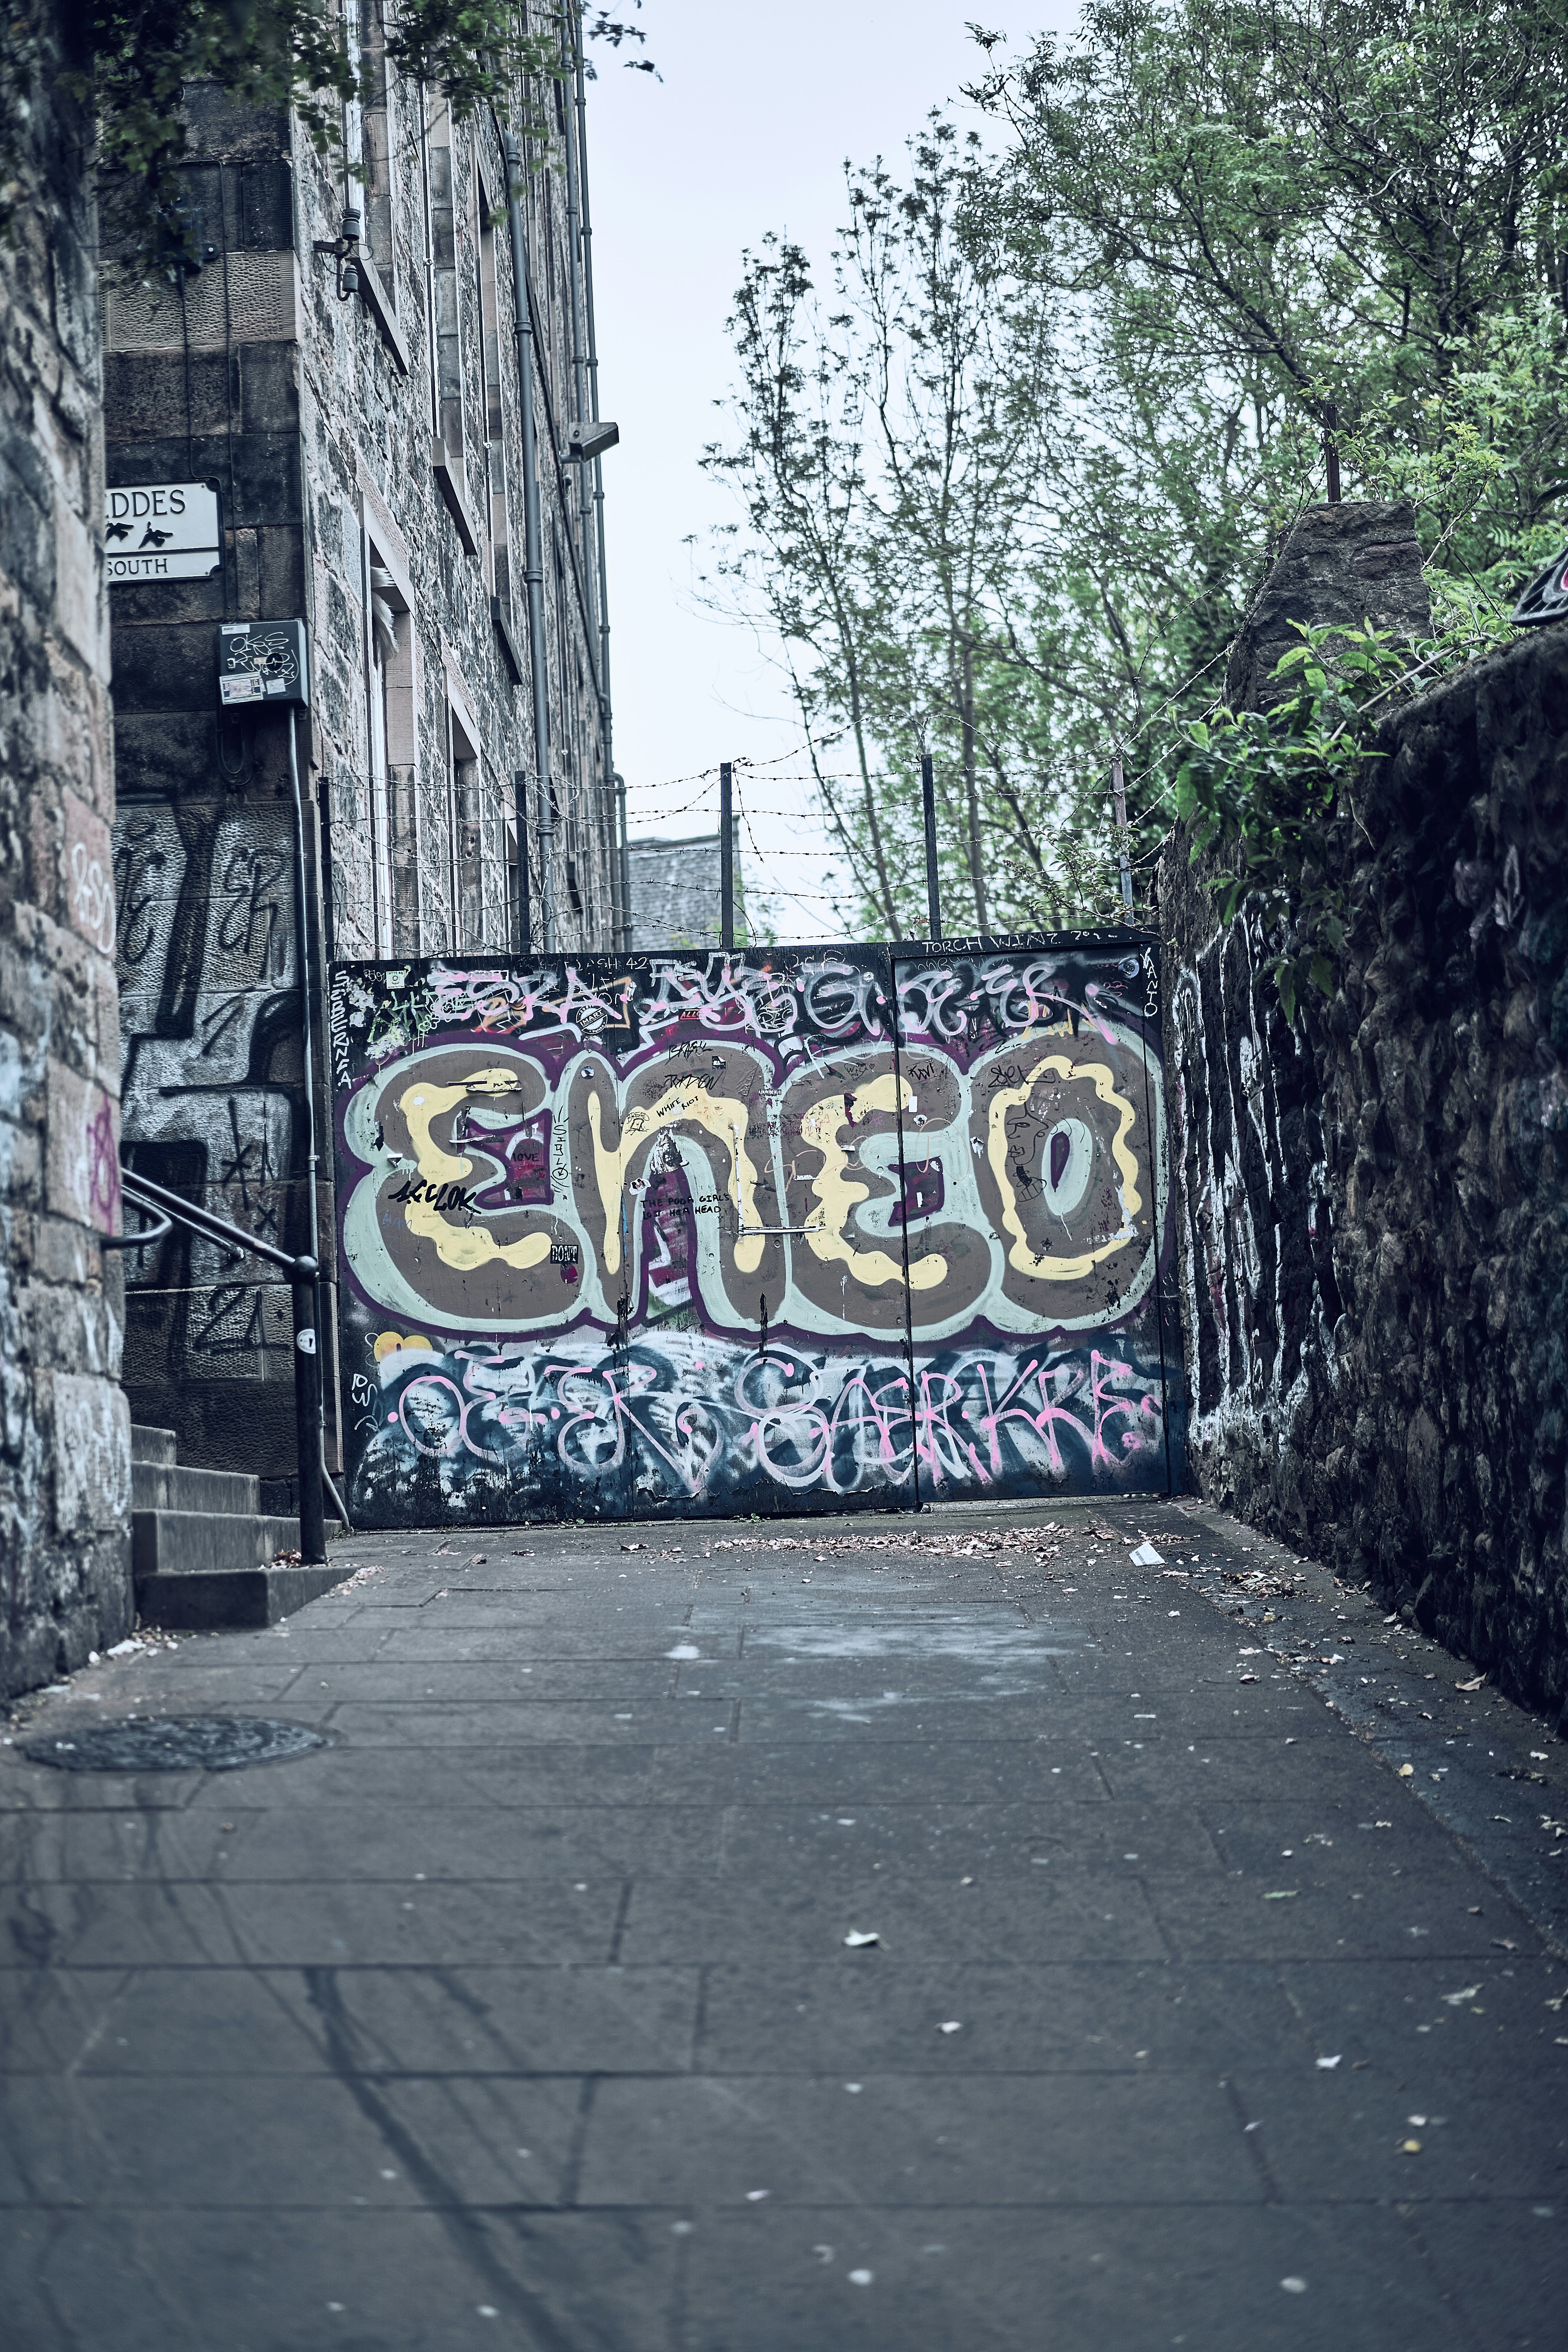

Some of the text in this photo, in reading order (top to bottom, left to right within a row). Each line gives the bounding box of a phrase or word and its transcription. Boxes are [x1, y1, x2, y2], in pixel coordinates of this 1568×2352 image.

[105, 490, 186, 518] DDES
[922, 936, 983, 954] TORCH
[580, 1009, 602, 1026] IMART
[656, 1096, 699, 1117] WHITE RIOT
[626, 1111, 650, 1124] BREAD
[640, 1193, 730, 1208] THE POOR GIRL'S
[642, 1210, 661, 1220] LOST
[669, 1208, 690, 1216] HER
